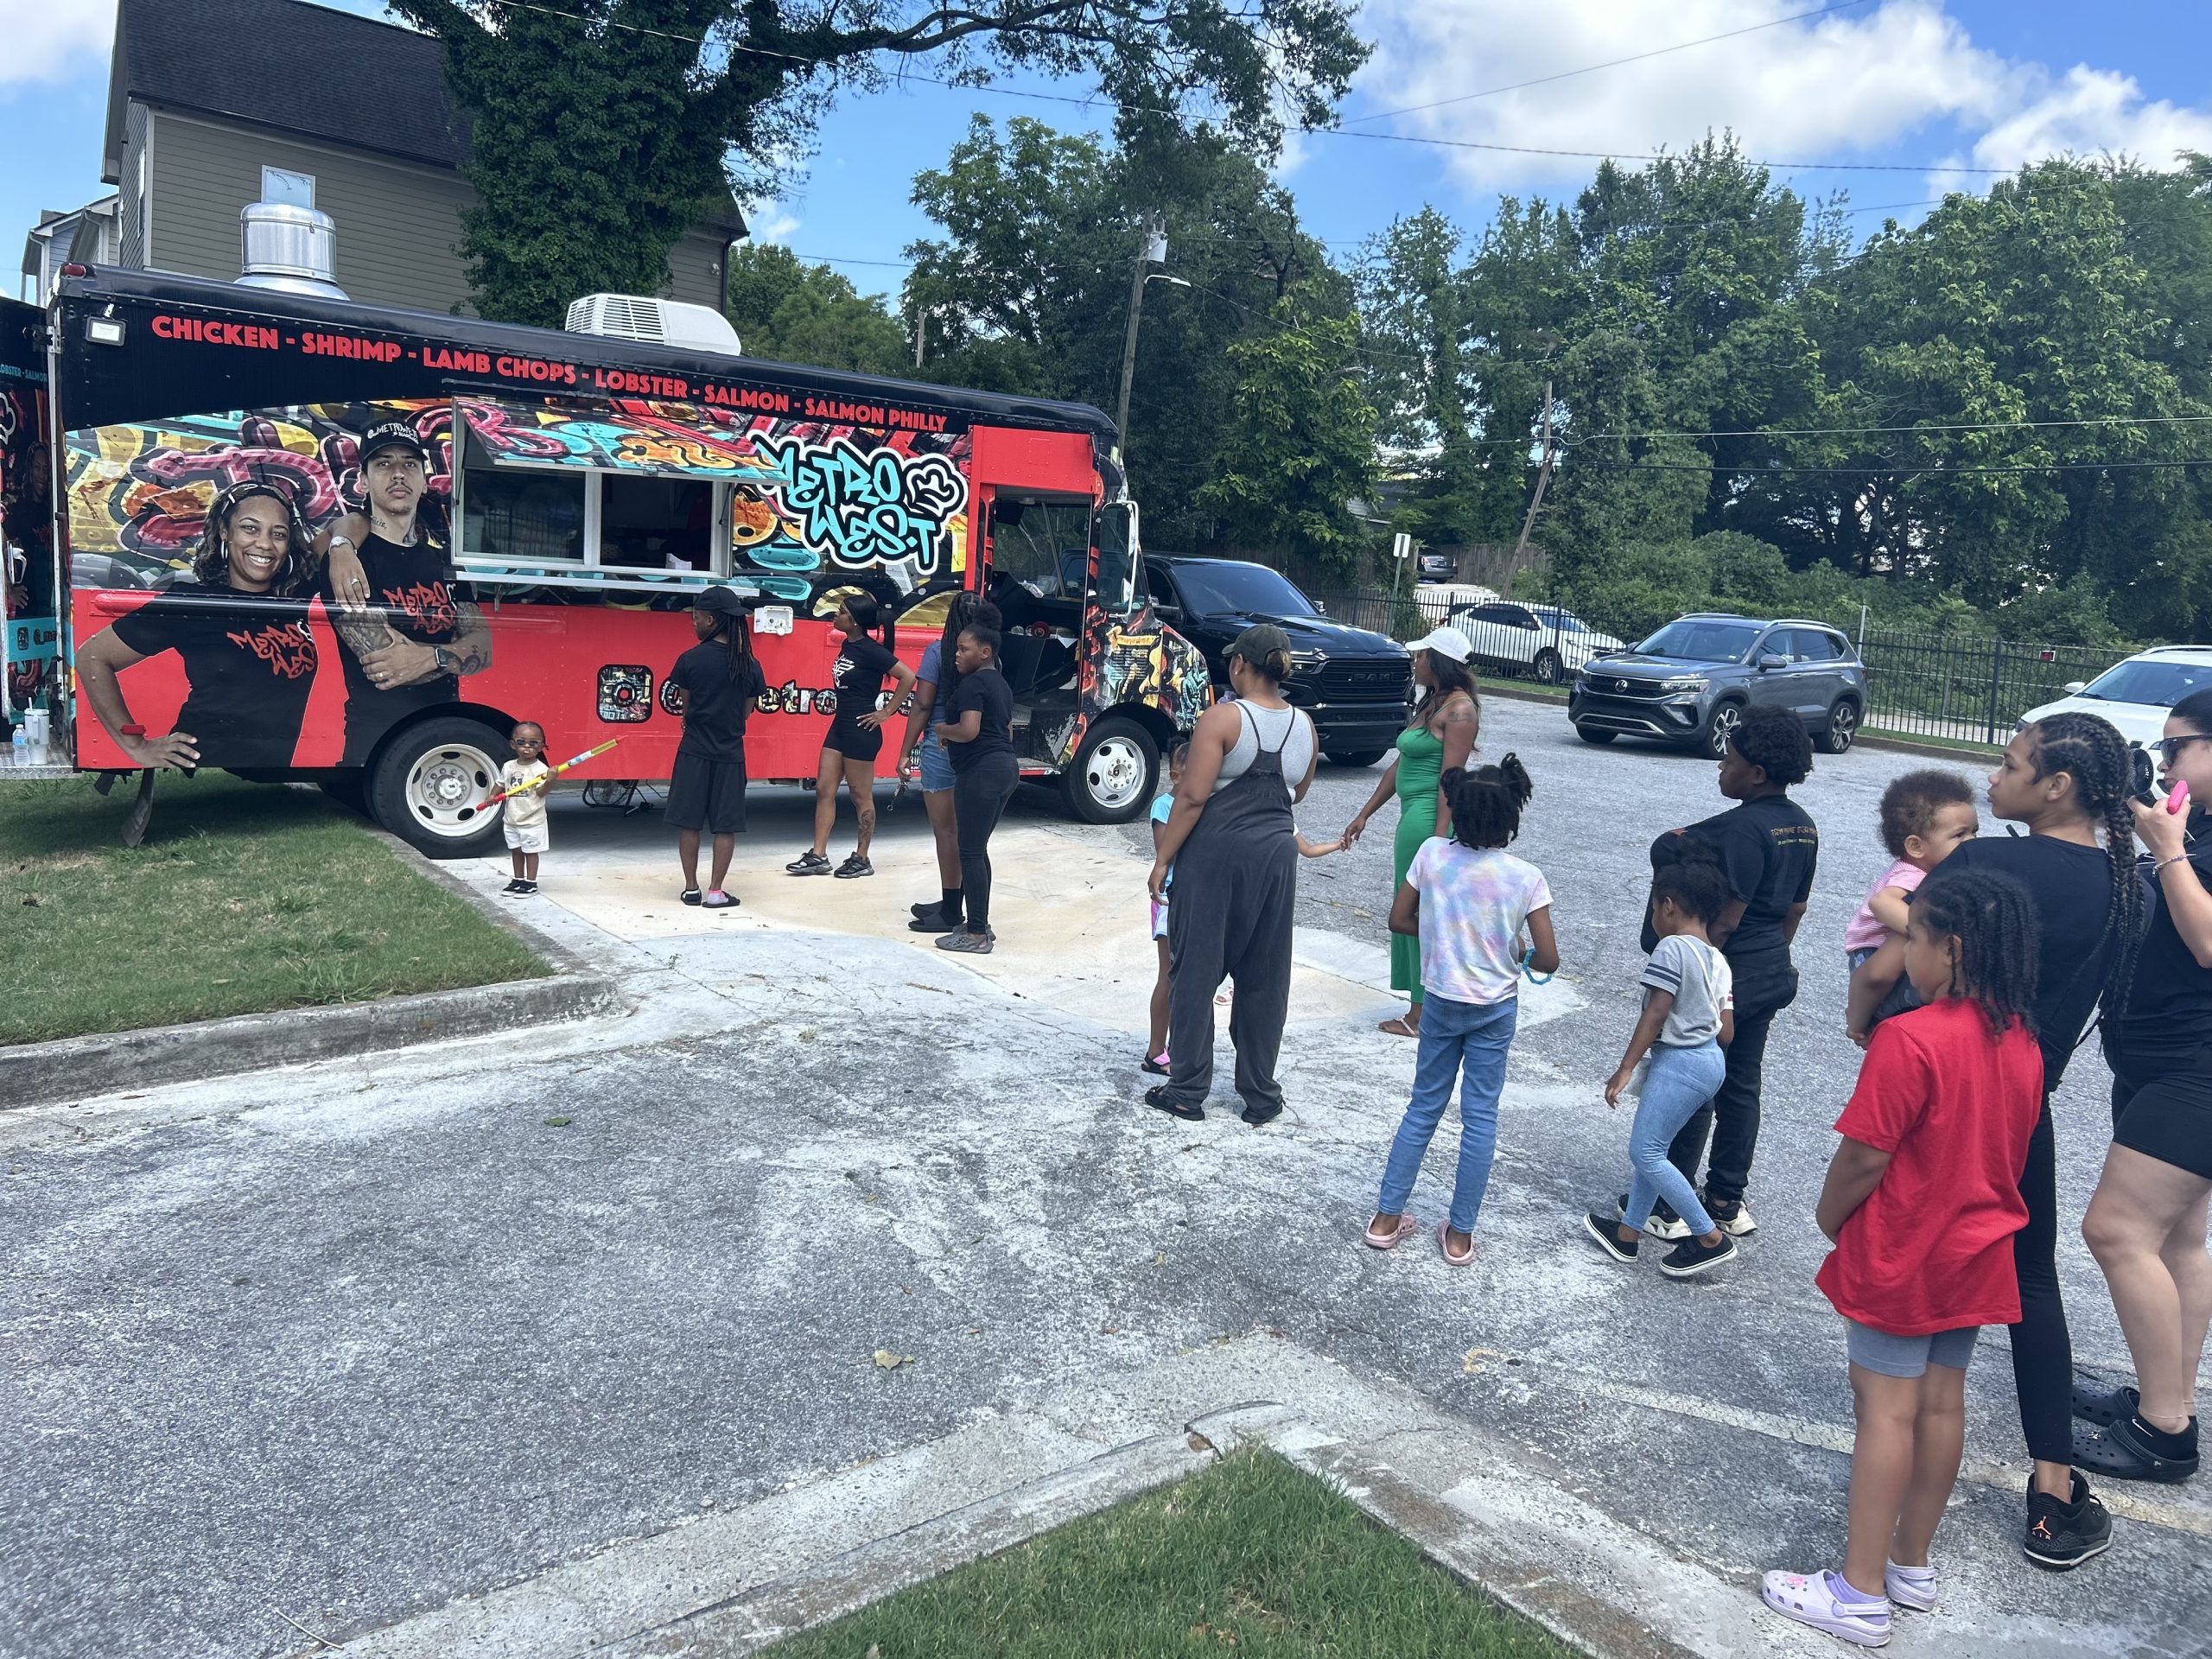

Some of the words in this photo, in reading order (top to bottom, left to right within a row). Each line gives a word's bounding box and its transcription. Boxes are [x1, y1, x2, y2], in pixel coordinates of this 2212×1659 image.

[0, 363, 22, 378] OBSTER
[151, 315, 278, 349] CHICKEN
[302, 332, 402, 362] SHRIMP
[423, 346, 491, 373] LAMB
[496, 356, 576, 385] CHOPS
[595, 367, 689, 398] LOBSTER
[704, 385, 789, 412] SALMON
[804, 397, 885, 424] SALMON
[887, 408, 948, 432] PHILLY
[754, 441, 901, 510] METRO
[2031, 1530, 2050, 1541] AIR
